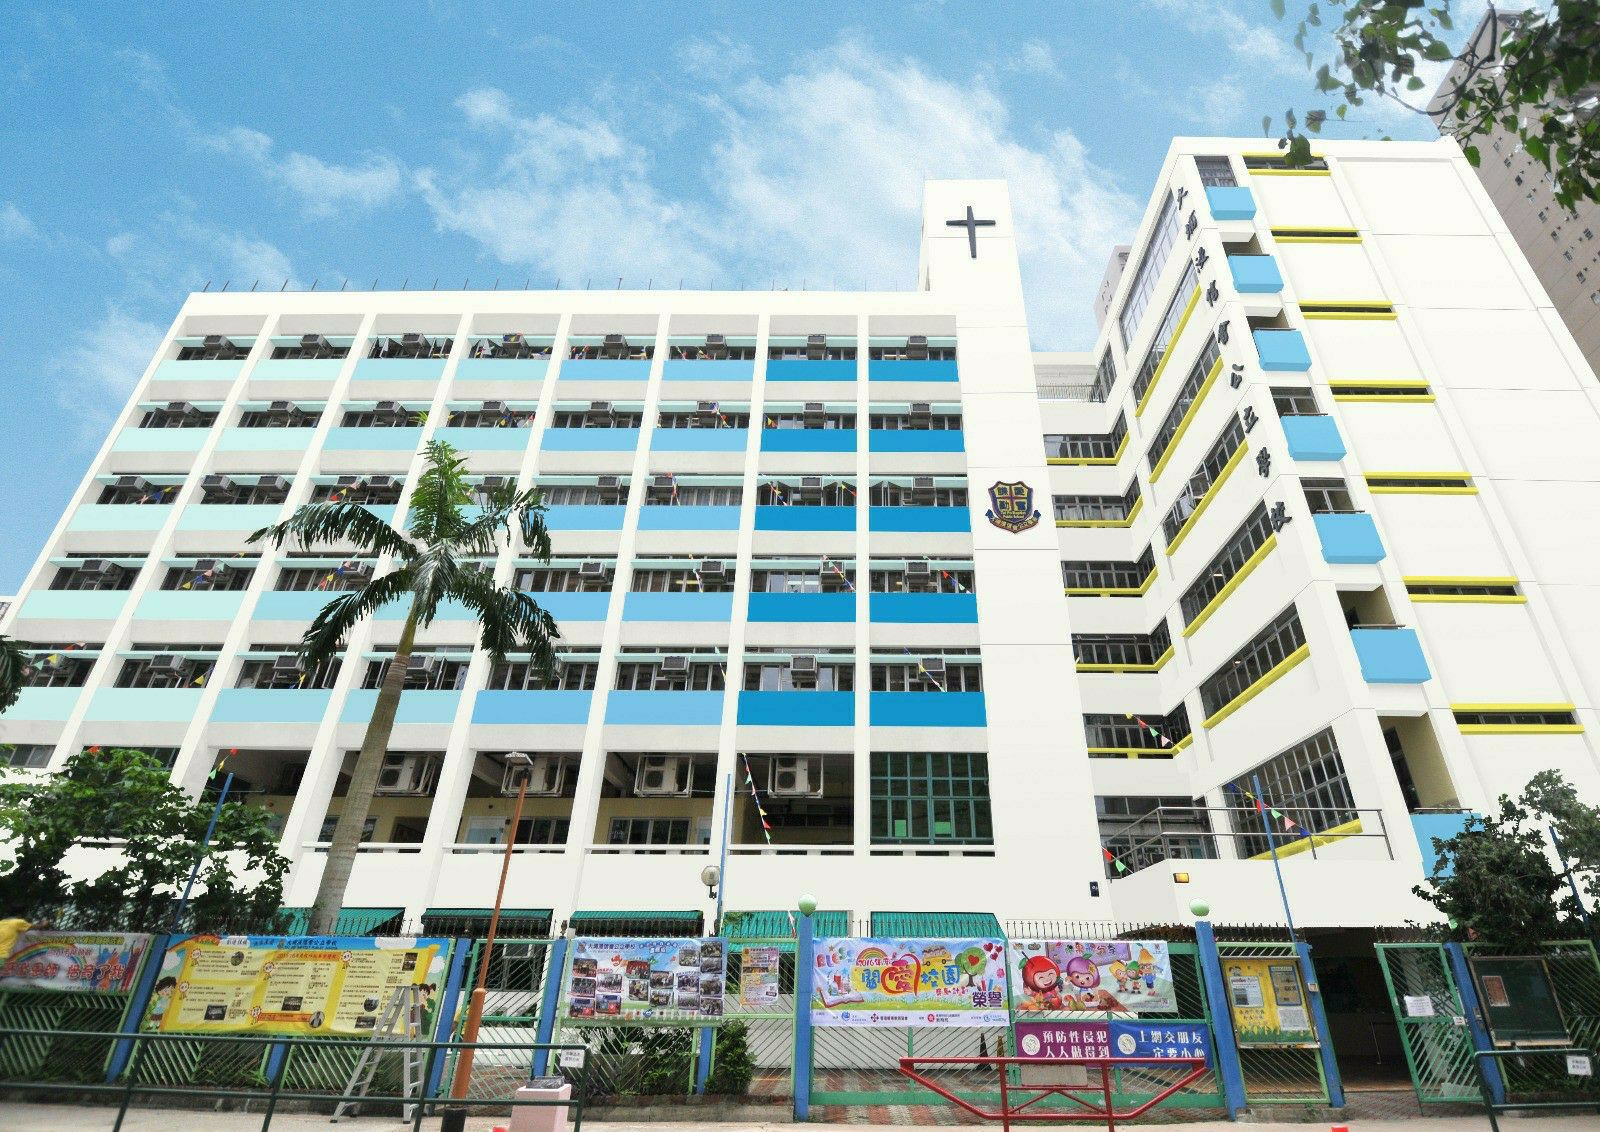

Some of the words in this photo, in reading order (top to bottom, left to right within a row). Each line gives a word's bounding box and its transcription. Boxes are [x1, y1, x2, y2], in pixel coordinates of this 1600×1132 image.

[972, 991, 1003, 1008] 榮譽
[1042, 1030, 1108, 1043] 預防性侵犯
[1139, 1030, 1202, 1044] 上網交朋友
